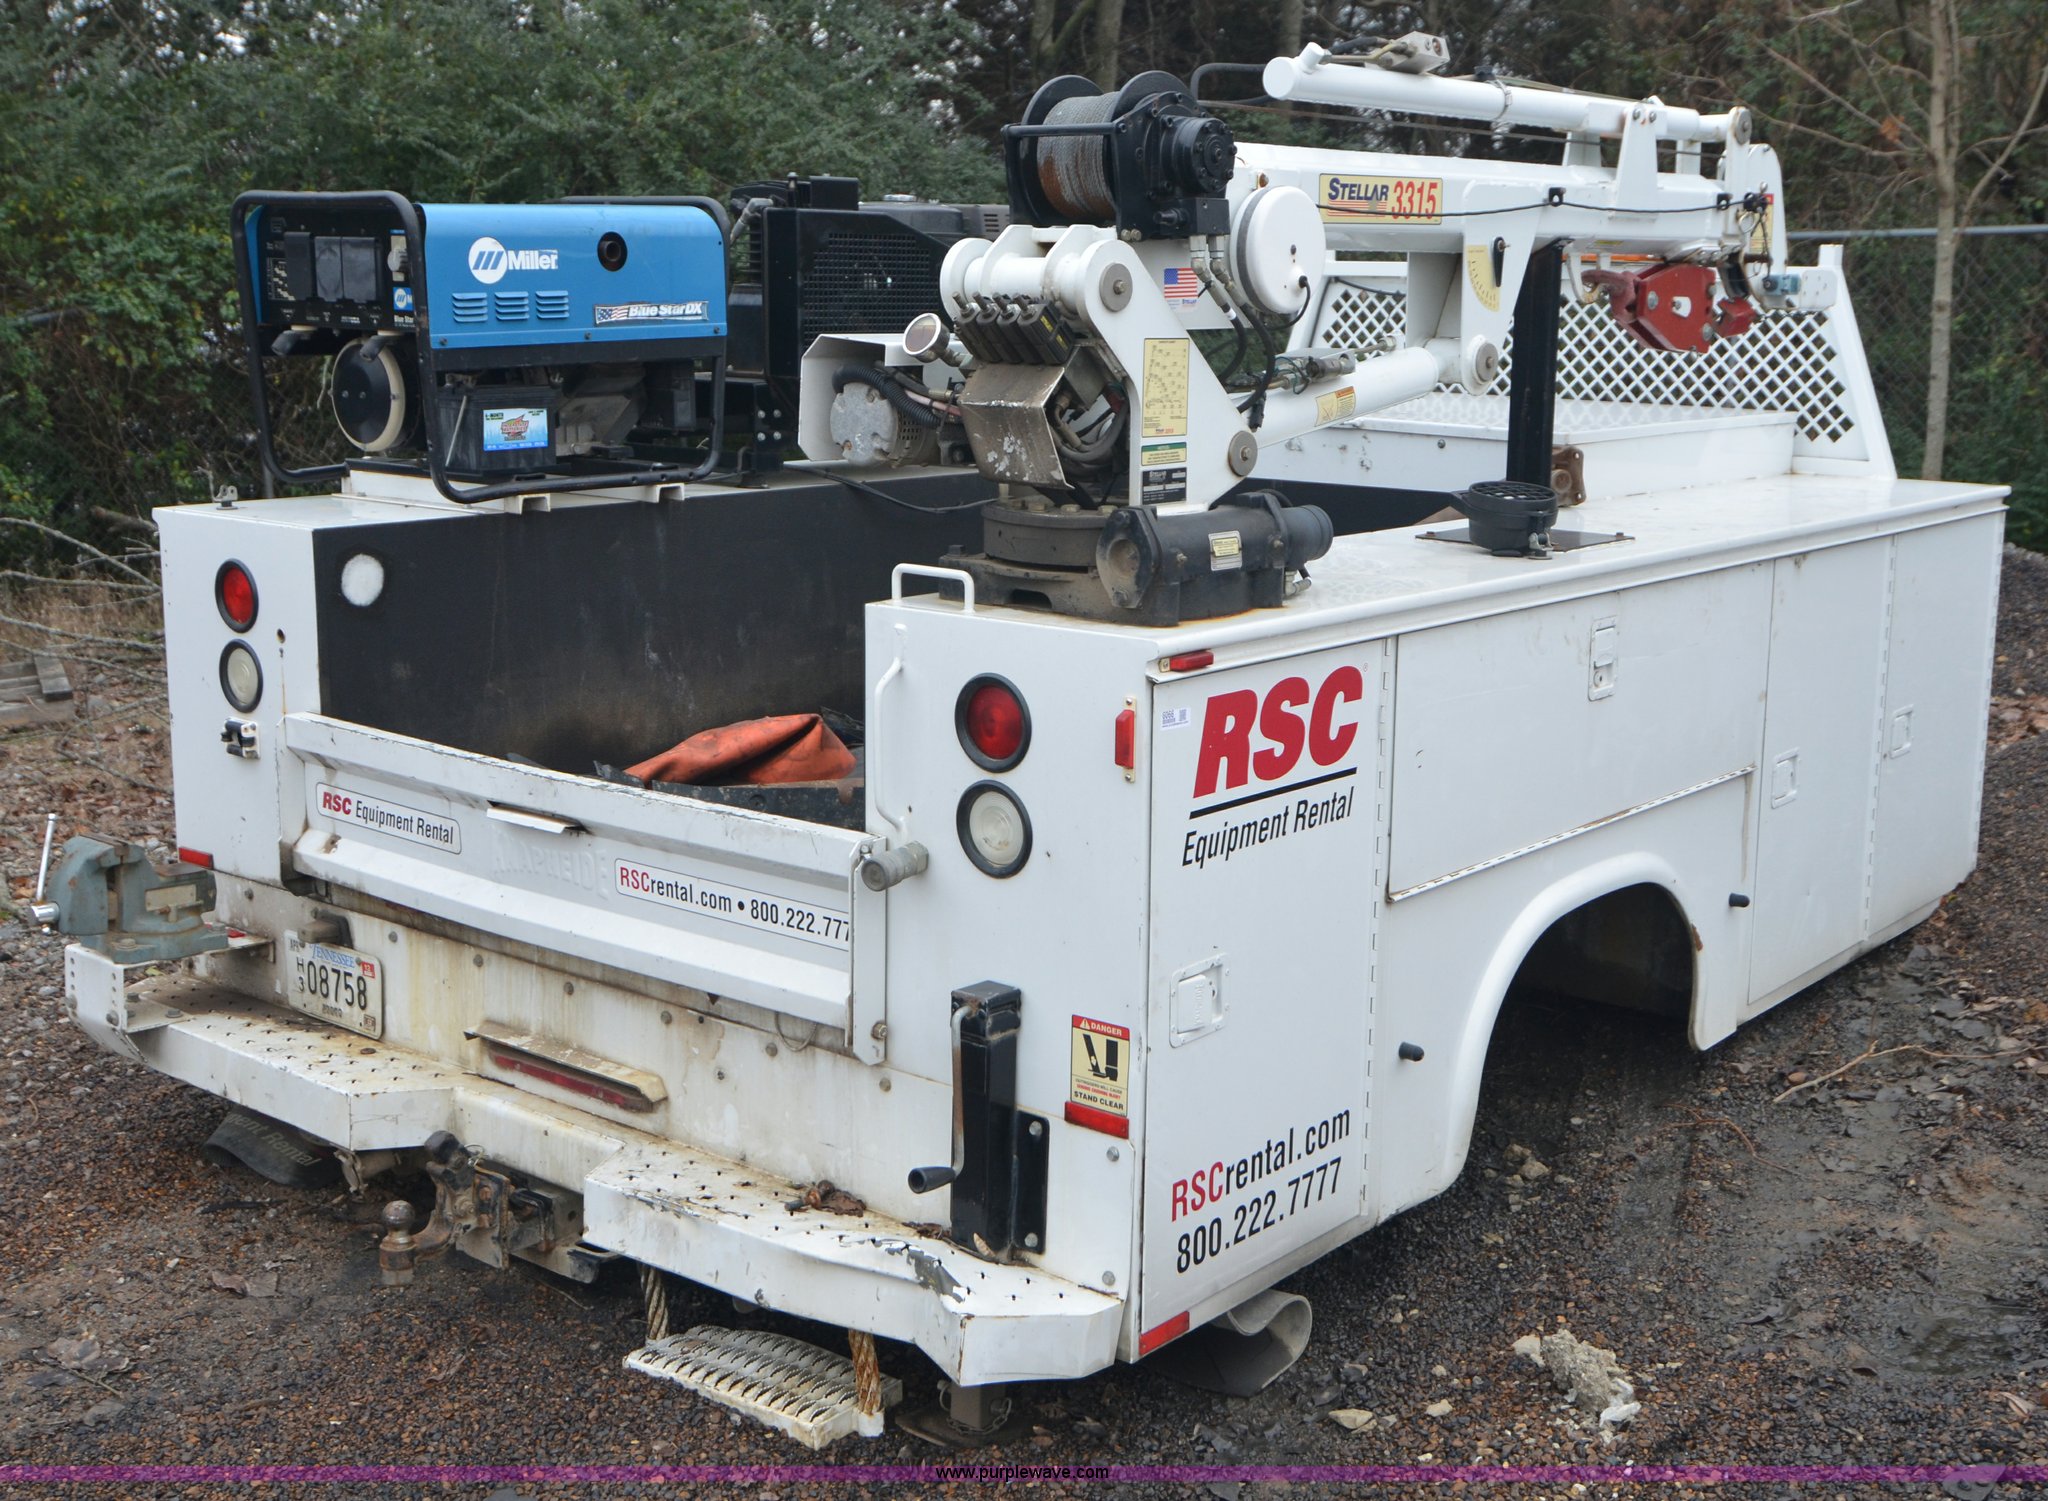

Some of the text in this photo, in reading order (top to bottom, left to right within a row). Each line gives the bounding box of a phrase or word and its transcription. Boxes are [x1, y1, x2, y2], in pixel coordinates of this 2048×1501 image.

[1327, 177, 1438, 220] STELLAR 3315
[507, 249, 558, 270] Miller
[628, 304, 658, 317] Blue
[1193, 666, 1363, 799] RSC
[322, 791, 453, 845] RSC Equipment Rental
[1182, 786, 1355, 869] Equipment Rental
[620, 866, 732, 913] RSCrental.com
[307, 960, 367, 1011] 08758
[1090, 1022, 1122, 1037] DANGER
[1074, 1090, 1124, 1111] STAND CLEAR
[261, 1131, 323, 1167] Rental
[1171, 1109, 1350, 1222] RSCrental.com
[1176, 1156, 1342, 1274] 800.222.7777
